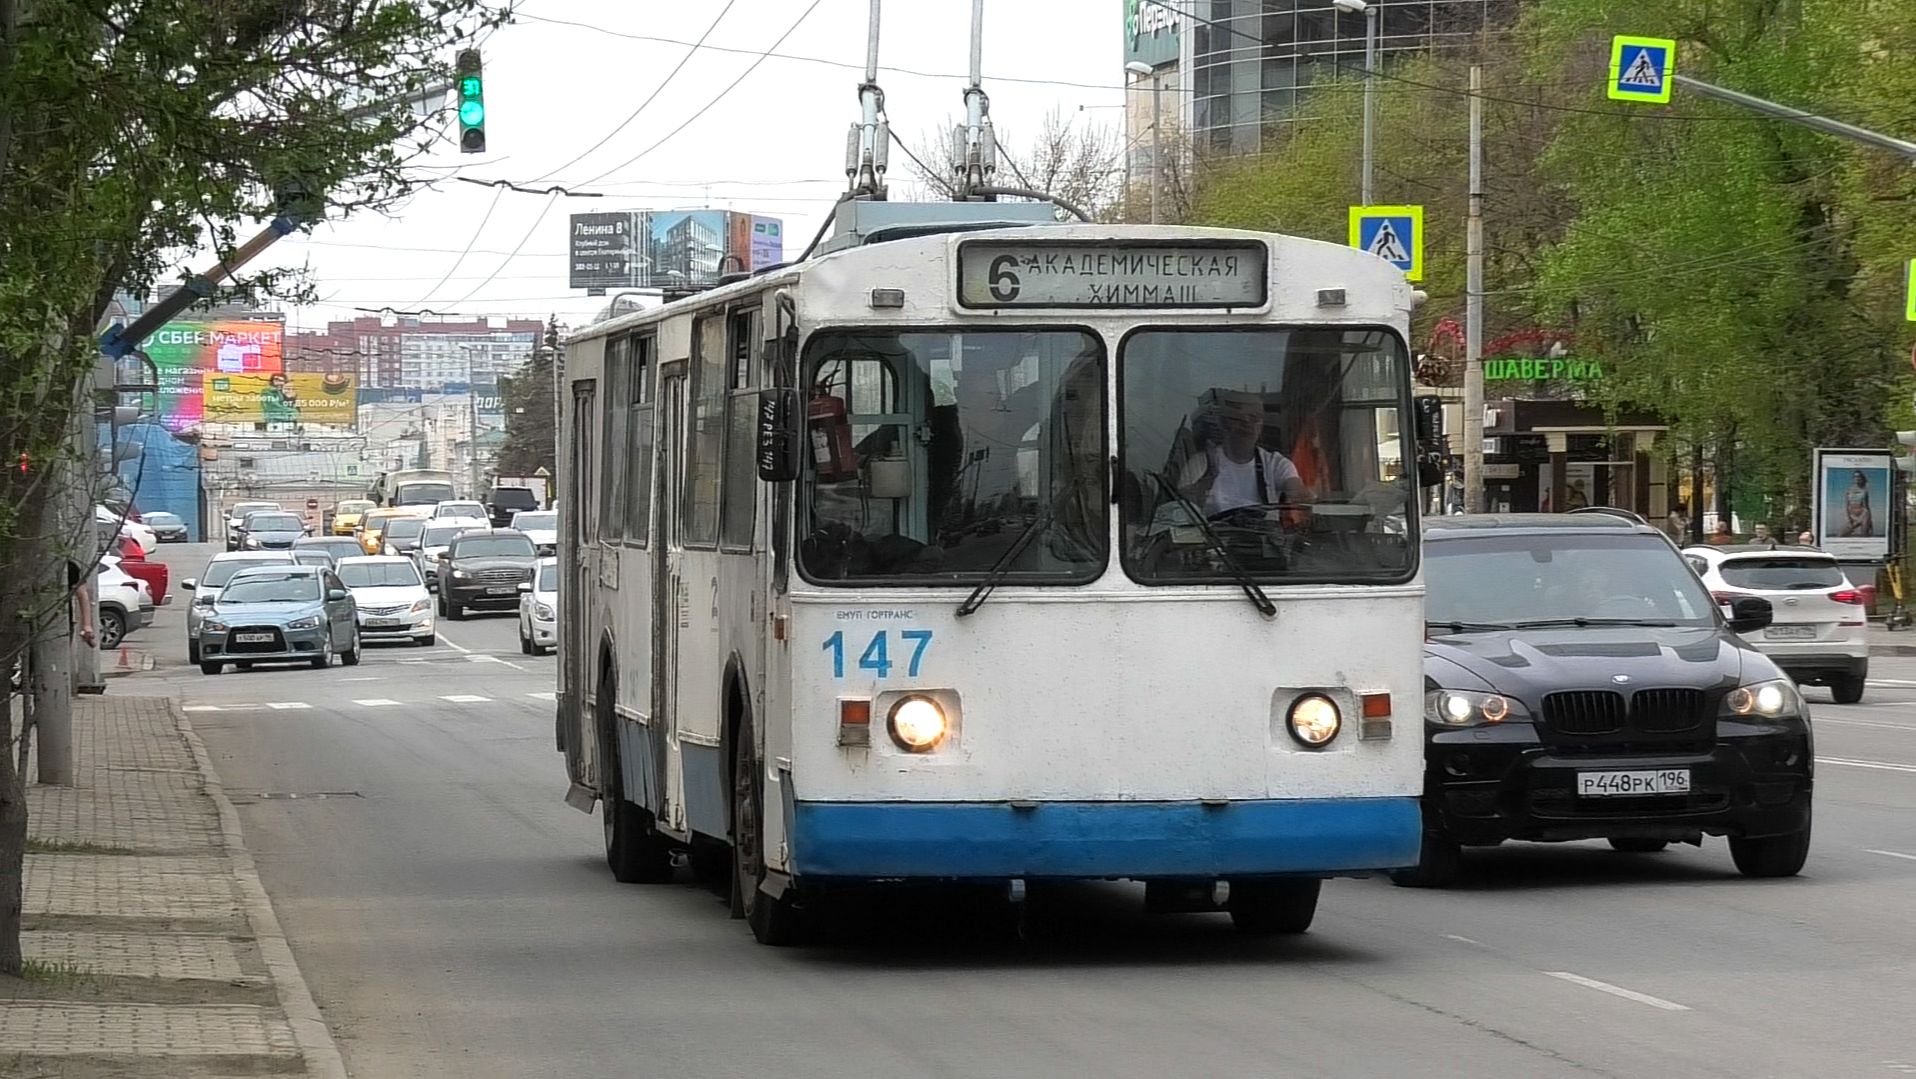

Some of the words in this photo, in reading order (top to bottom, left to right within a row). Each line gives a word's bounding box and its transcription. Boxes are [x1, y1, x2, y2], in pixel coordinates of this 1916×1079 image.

[574, 223, 614, 235] Ленина
[616, 222, 623, 234] 8
[1028, 253, 1238, 277] АКАДЕМИЧЕСКАЯ
[988, 254, 1021, 302] 6
[1089, 283, 1197, 304] ХИММАШ
[1484, 359, 1603, 380] ШАВЕРМА
[866, 610, 913, 619] ГОРТРАНС
[822, 630, 933, 678] 147
[1584, 774, 1655, 792] Р448РК
[1659, 771, 1685, 786] 196
